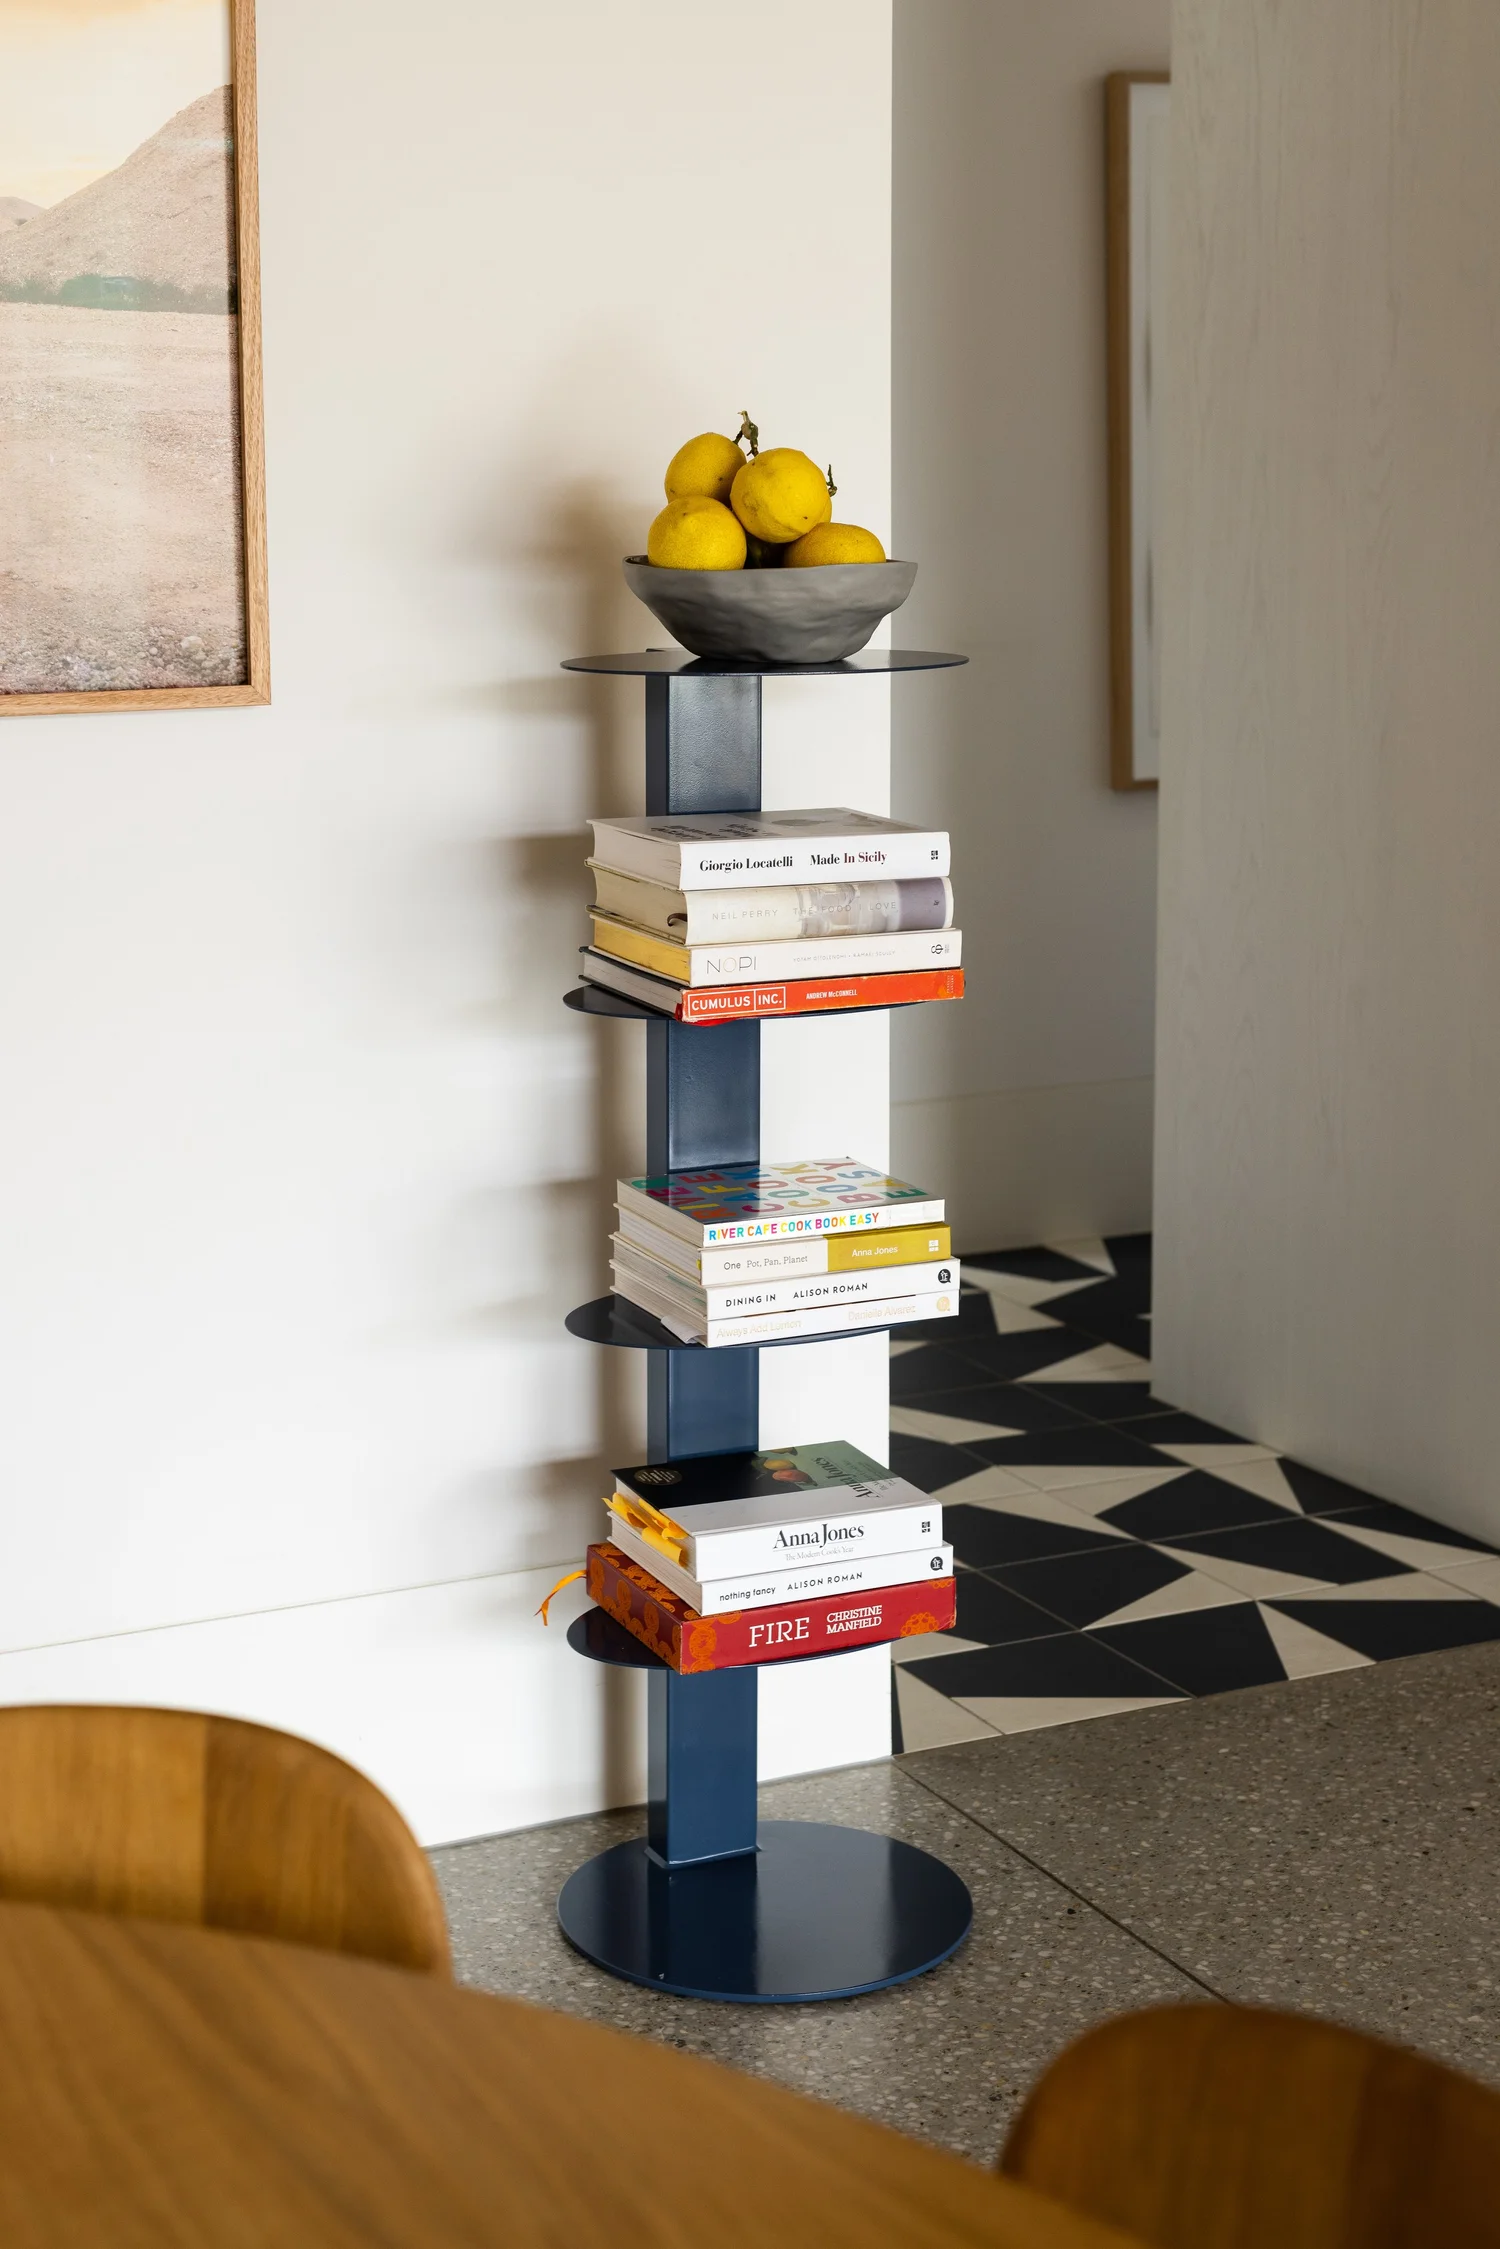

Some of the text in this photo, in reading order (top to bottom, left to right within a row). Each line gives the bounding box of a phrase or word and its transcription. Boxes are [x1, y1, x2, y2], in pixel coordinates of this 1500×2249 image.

[700, 856, 793, 873] Giorgio Locatelli
[810, 851, 887, 866] Made In Sicily
[713, 910, 779, 920] NEIL PERRY
[793, 907, 814, 916] THE
[821, 904, 852, 913] FOOD
[869, 901, 898, 911] LOVE
[706, 956, 757, 974] NOPI
[692, 994, 783, 1010] CUMULUS INC.
[806, 990, 858, 1000] ANDREW McCONNELL
[709, 1212, 880, 1240] RIVER CAFE COOK BOOK EASY
[852, 1246, 898, 1258] Anna Jones
[724, 1262, 742, 1270] One
[746, 1260, 762, 1268] Pot,
[784, 1256, 808, 1265] Planet
[793, 1282, 868, 1299] ALISON ROMAN
[726, 1294, 776, 1308] DINING IN
[848, 1304, 916, 1321] Danielle Alvarez
[716, 1326, 748, 1338] Always
[750, 1322, 768, 1333] Add
[773, 1523, 865, 1549] Anna Jones
[786, 1553, 796, 1561] The
[796, 1550, 820, 1559] Modern
[788, 1572, 863, 1590] ALISON ROMAN
[720, 1586, 776, 1602] nothing fancy
[826, 1605, 882, 1622] CHRISTINE
[749, 1617, 810, 1648] FIRE
[826, 1616, 882, 1634] MANFIELD
